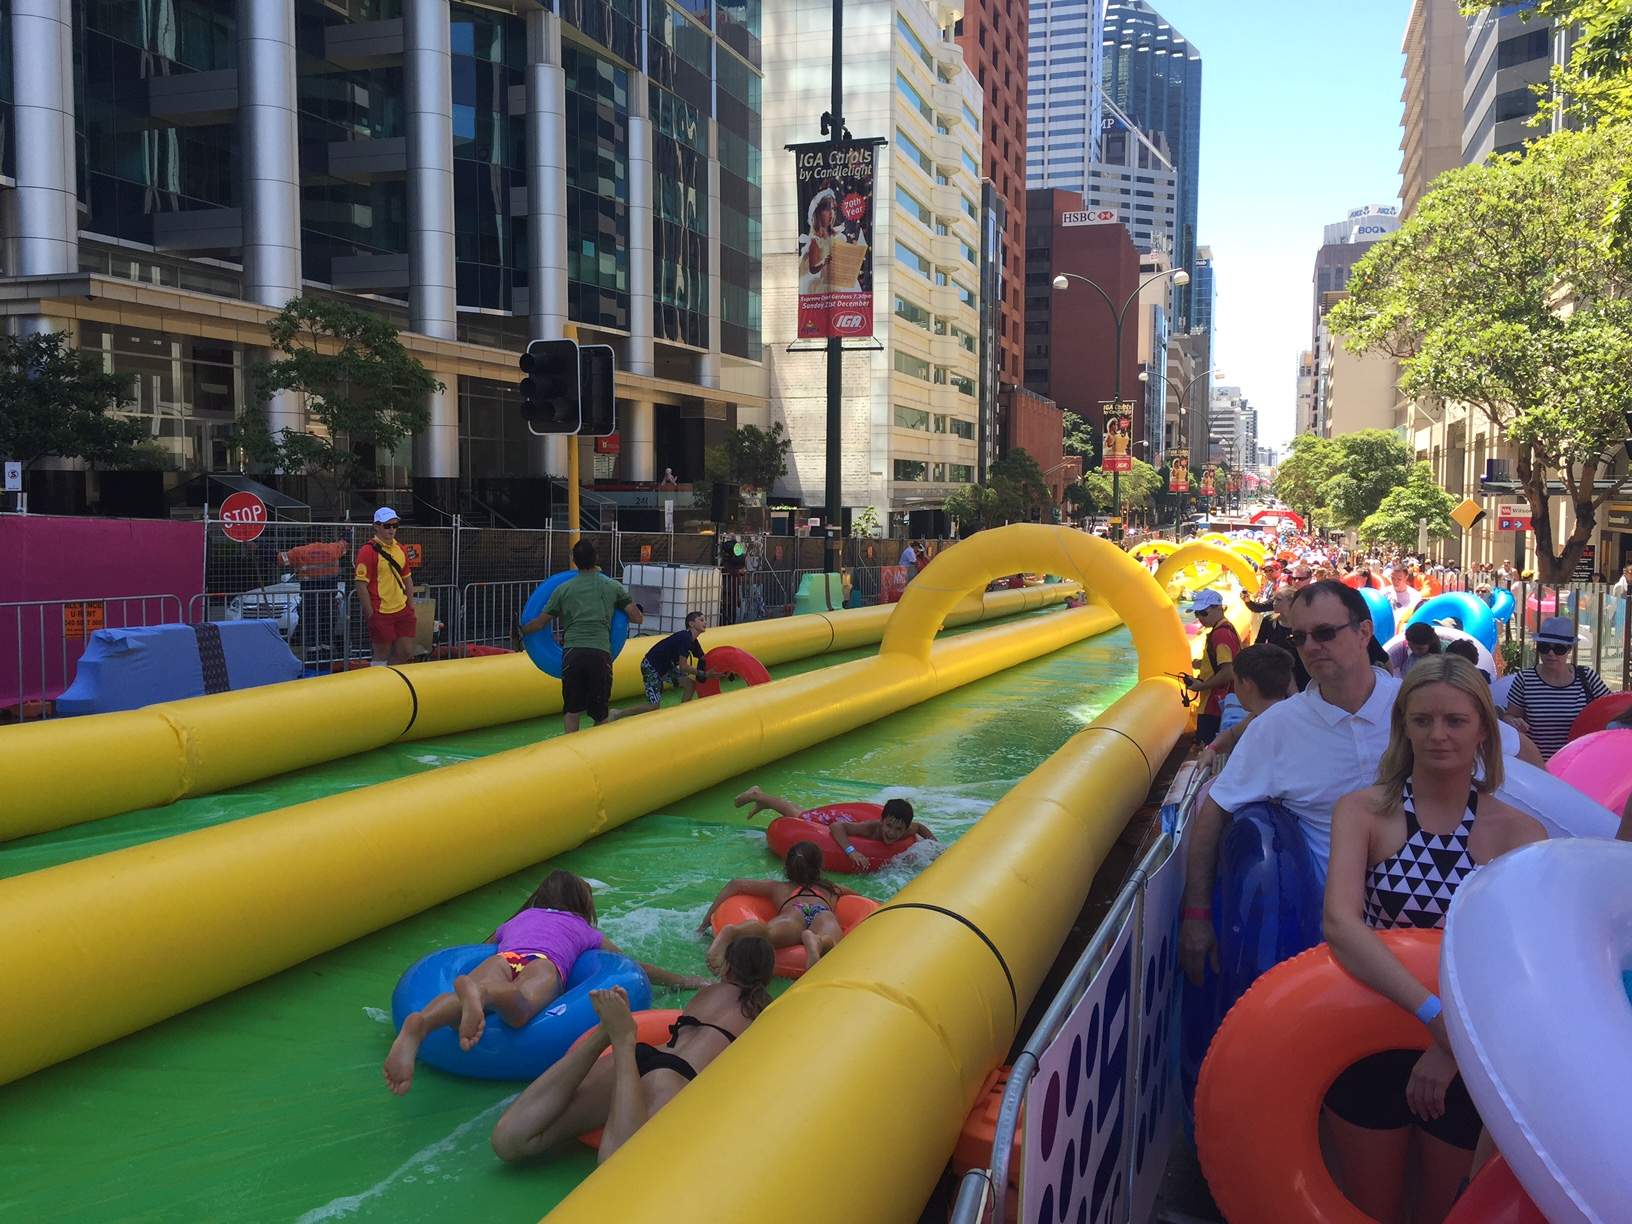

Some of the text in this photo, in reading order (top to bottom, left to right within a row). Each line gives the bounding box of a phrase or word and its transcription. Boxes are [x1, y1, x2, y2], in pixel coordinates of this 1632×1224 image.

[799, 148, 872, 167] IGA Carols
[799, 164, 873, 182] by Candlelight
[846, 207, 863, 217] Year
[1063, 211, 1096, 223] HSBC
[1358, 226, 1378, 234] BOQ
[802, 302, 824, 311] Sunday
[837, 300, 870, 308] December
[836, 315, 862, 328] IGA
[223, 505, 262, 529] STOP
